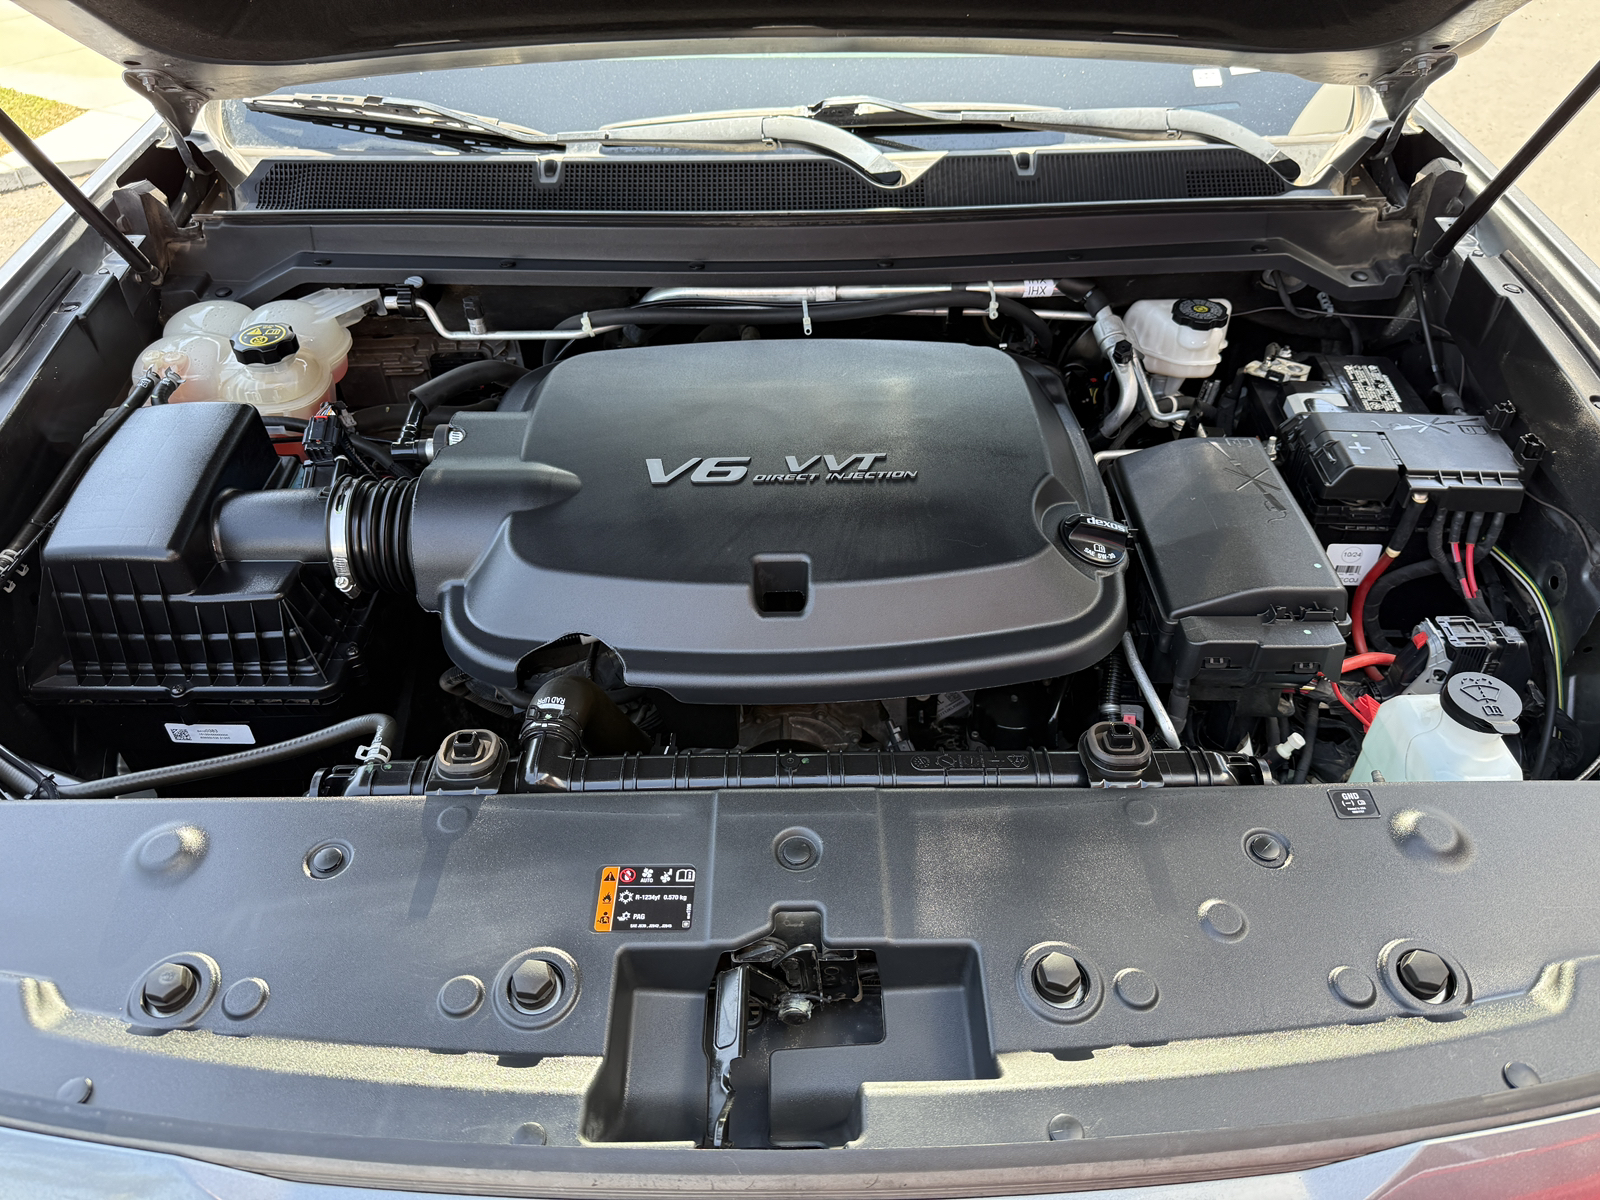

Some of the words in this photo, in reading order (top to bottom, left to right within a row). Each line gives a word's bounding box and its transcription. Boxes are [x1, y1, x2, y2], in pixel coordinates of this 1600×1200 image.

[1028, 286, 1047, 296] IHX
[645, 457, 752, 487] V6
[784, 453, 887, 474] VVT
[753, 473, 820, 483] DIRECT
[826, 470, 918, 483] INJECTION
[1086, 516, 1126, 533] dexos
[1083, 547, 1096, 557] SAE
[551, 696, 566, 705] RAD
[1341, 792, 1360, 801] GND
[679, 894, 688, 902] kg
